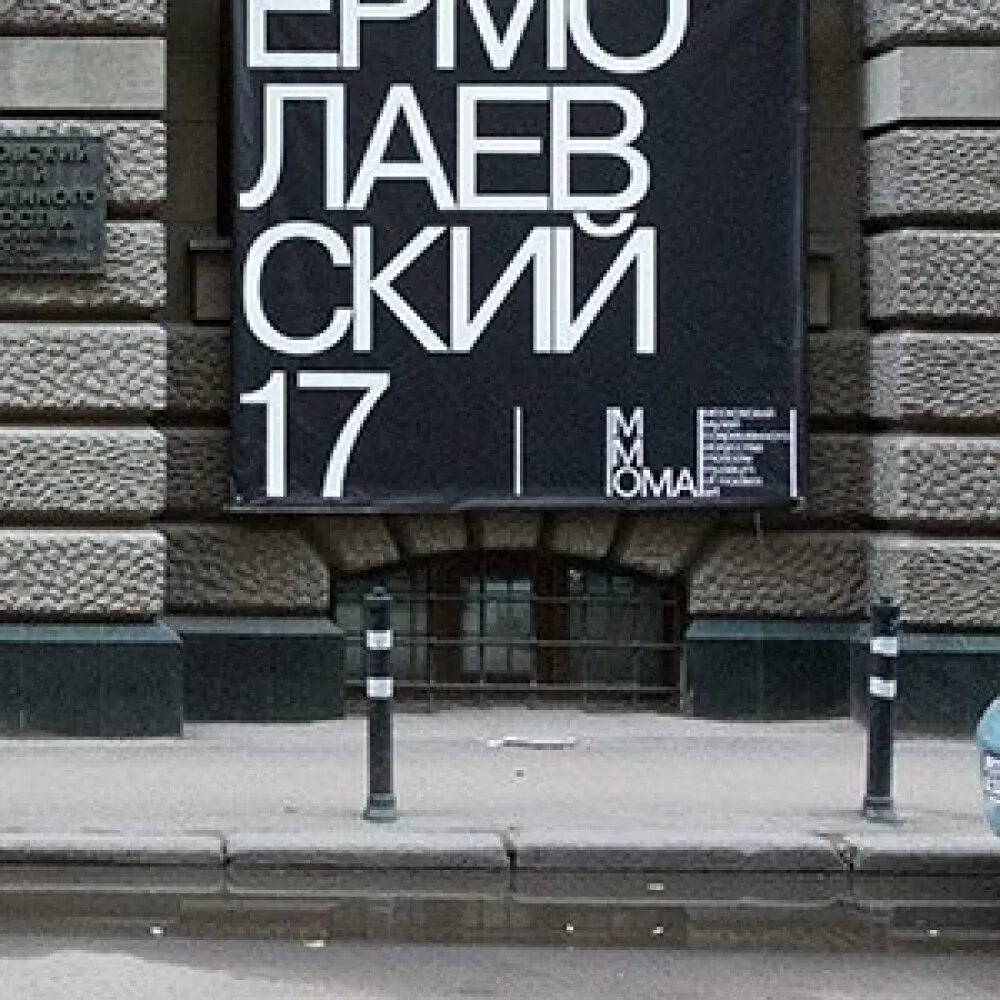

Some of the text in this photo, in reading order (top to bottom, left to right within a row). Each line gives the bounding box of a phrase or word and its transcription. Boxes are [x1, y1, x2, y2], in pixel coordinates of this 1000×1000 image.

[239, 83, 650, 211] ЛАЕВ
[242, 212, 657, 355] СКИЙ
[239, 371, 391, 498] 17
